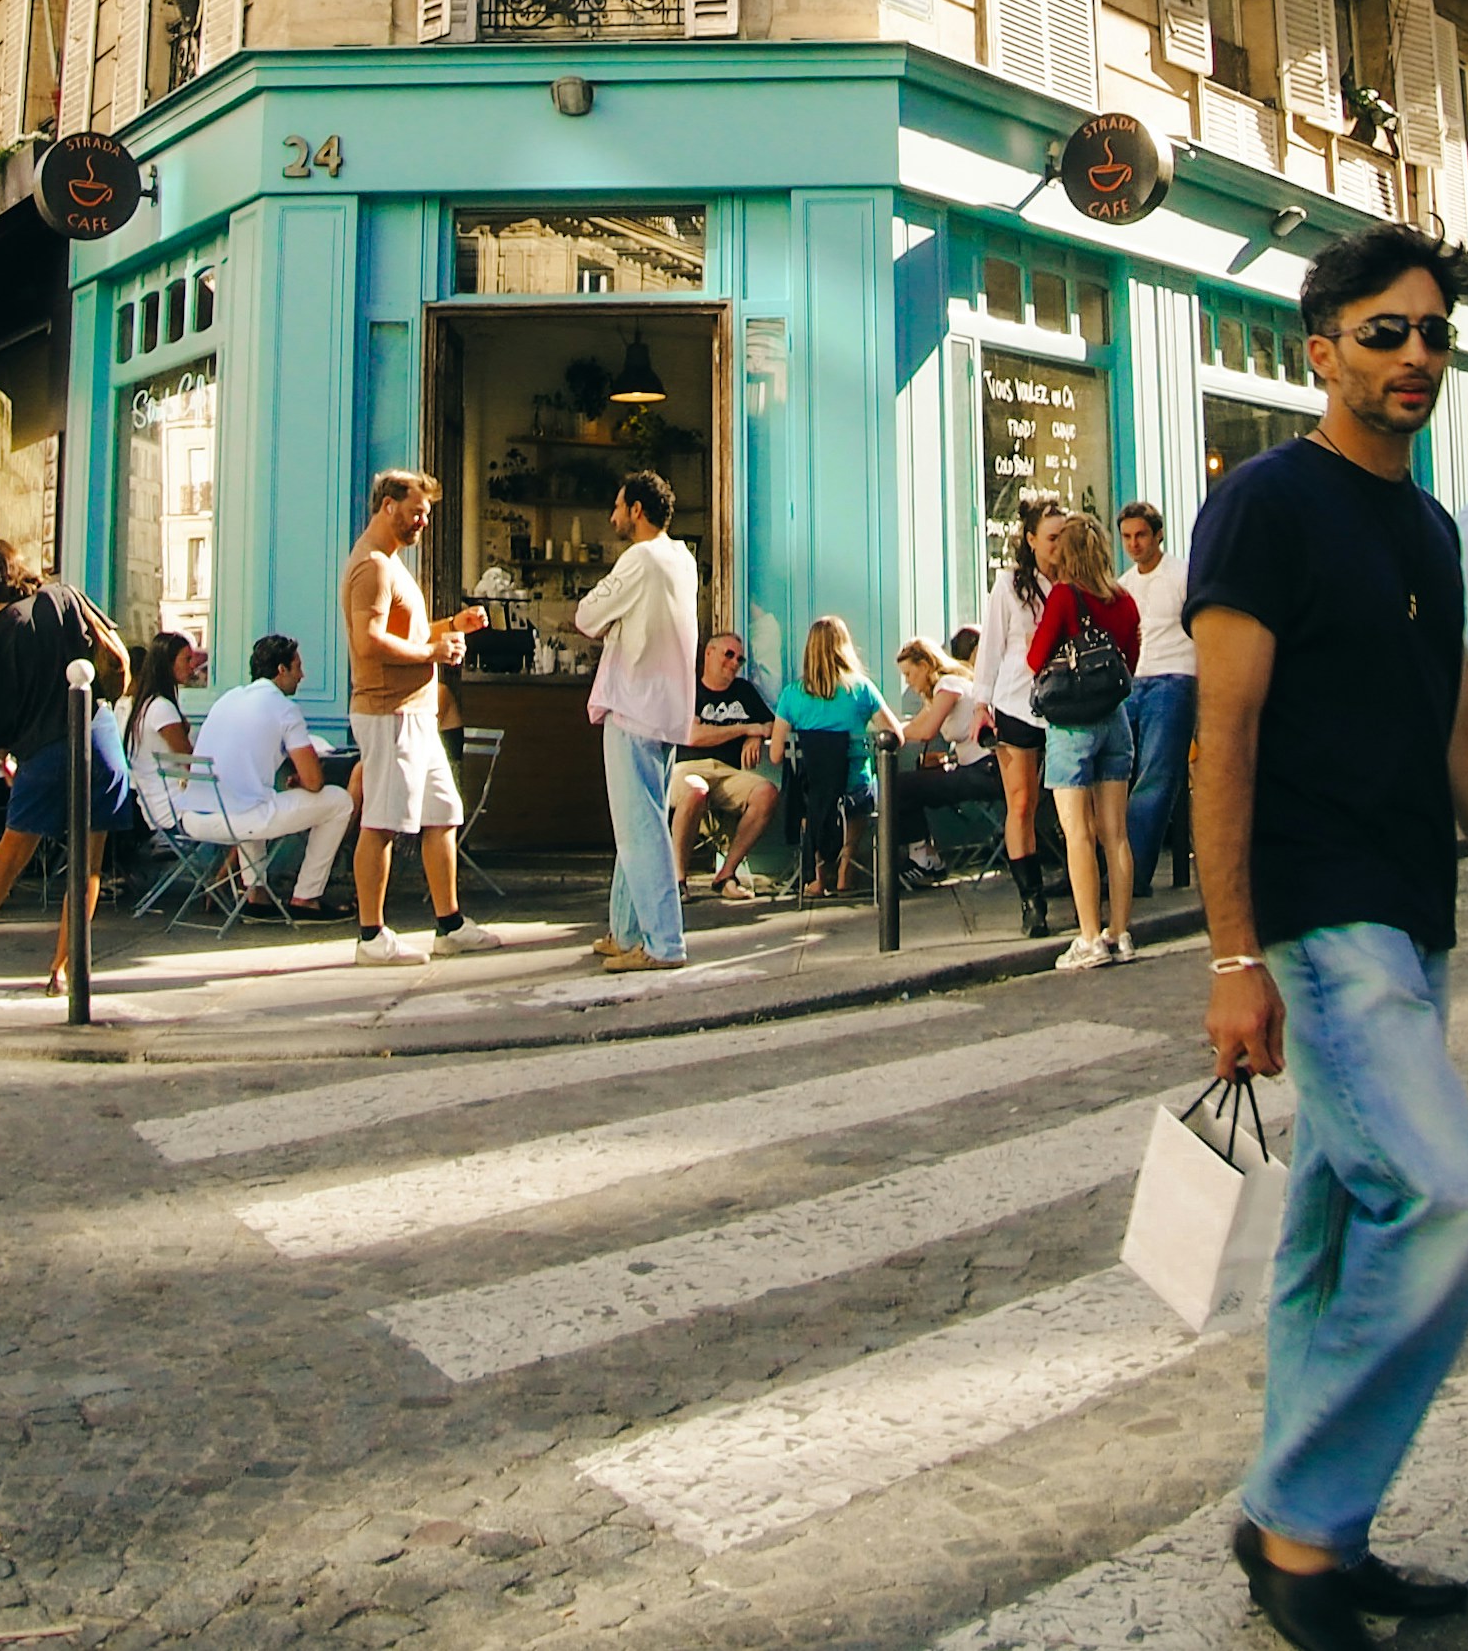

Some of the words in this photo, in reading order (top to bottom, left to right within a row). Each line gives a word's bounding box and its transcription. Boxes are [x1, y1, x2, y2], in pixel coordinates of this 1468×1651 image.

[1083, 116, 1137, 139] STRADA
[66, 136, 121, 158] STRADA
[282, 135, 343, 178] 24
[1087, 198, 1131, 219] CAFE
[67, 213, 111, 232] CAFE
[1014, 377, 1050, 405] VOULEZ
